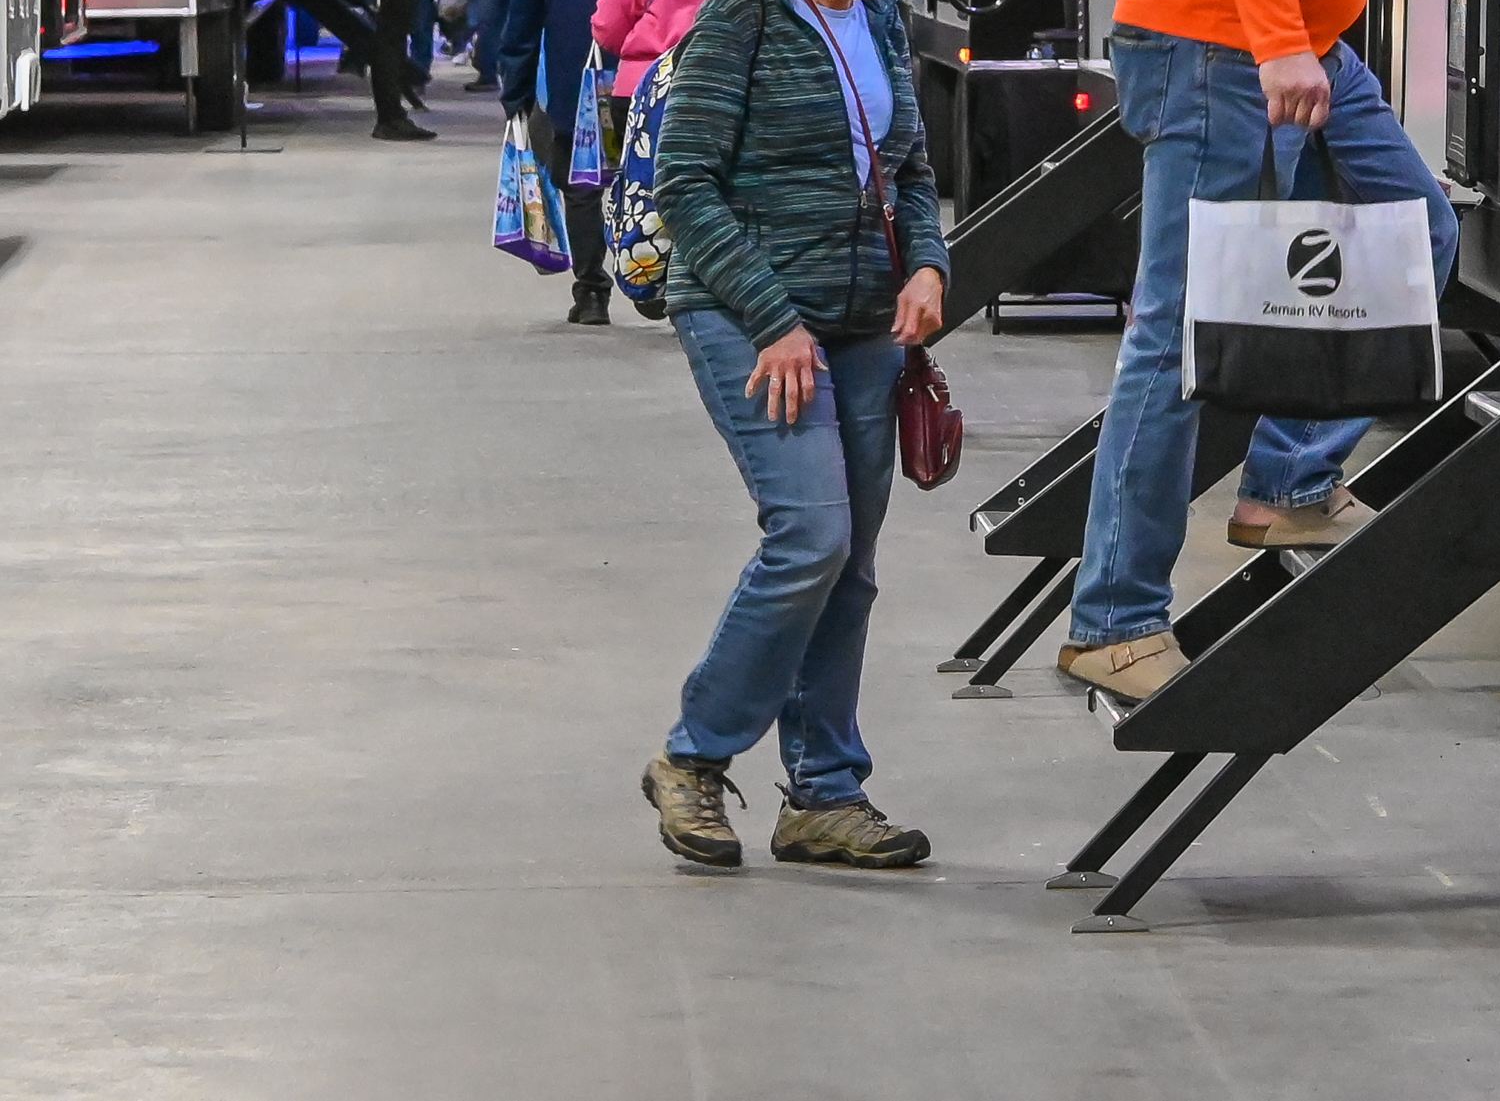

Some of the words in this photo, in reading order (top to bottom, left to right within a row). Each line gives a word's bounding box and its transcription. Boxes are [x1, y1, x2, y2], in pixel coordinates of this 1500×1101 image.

[1262, 300, 1305, 316] Zeman
[1308, 304, 1325, 318] RV
[1327, 304, 1367, 319] Resorts
